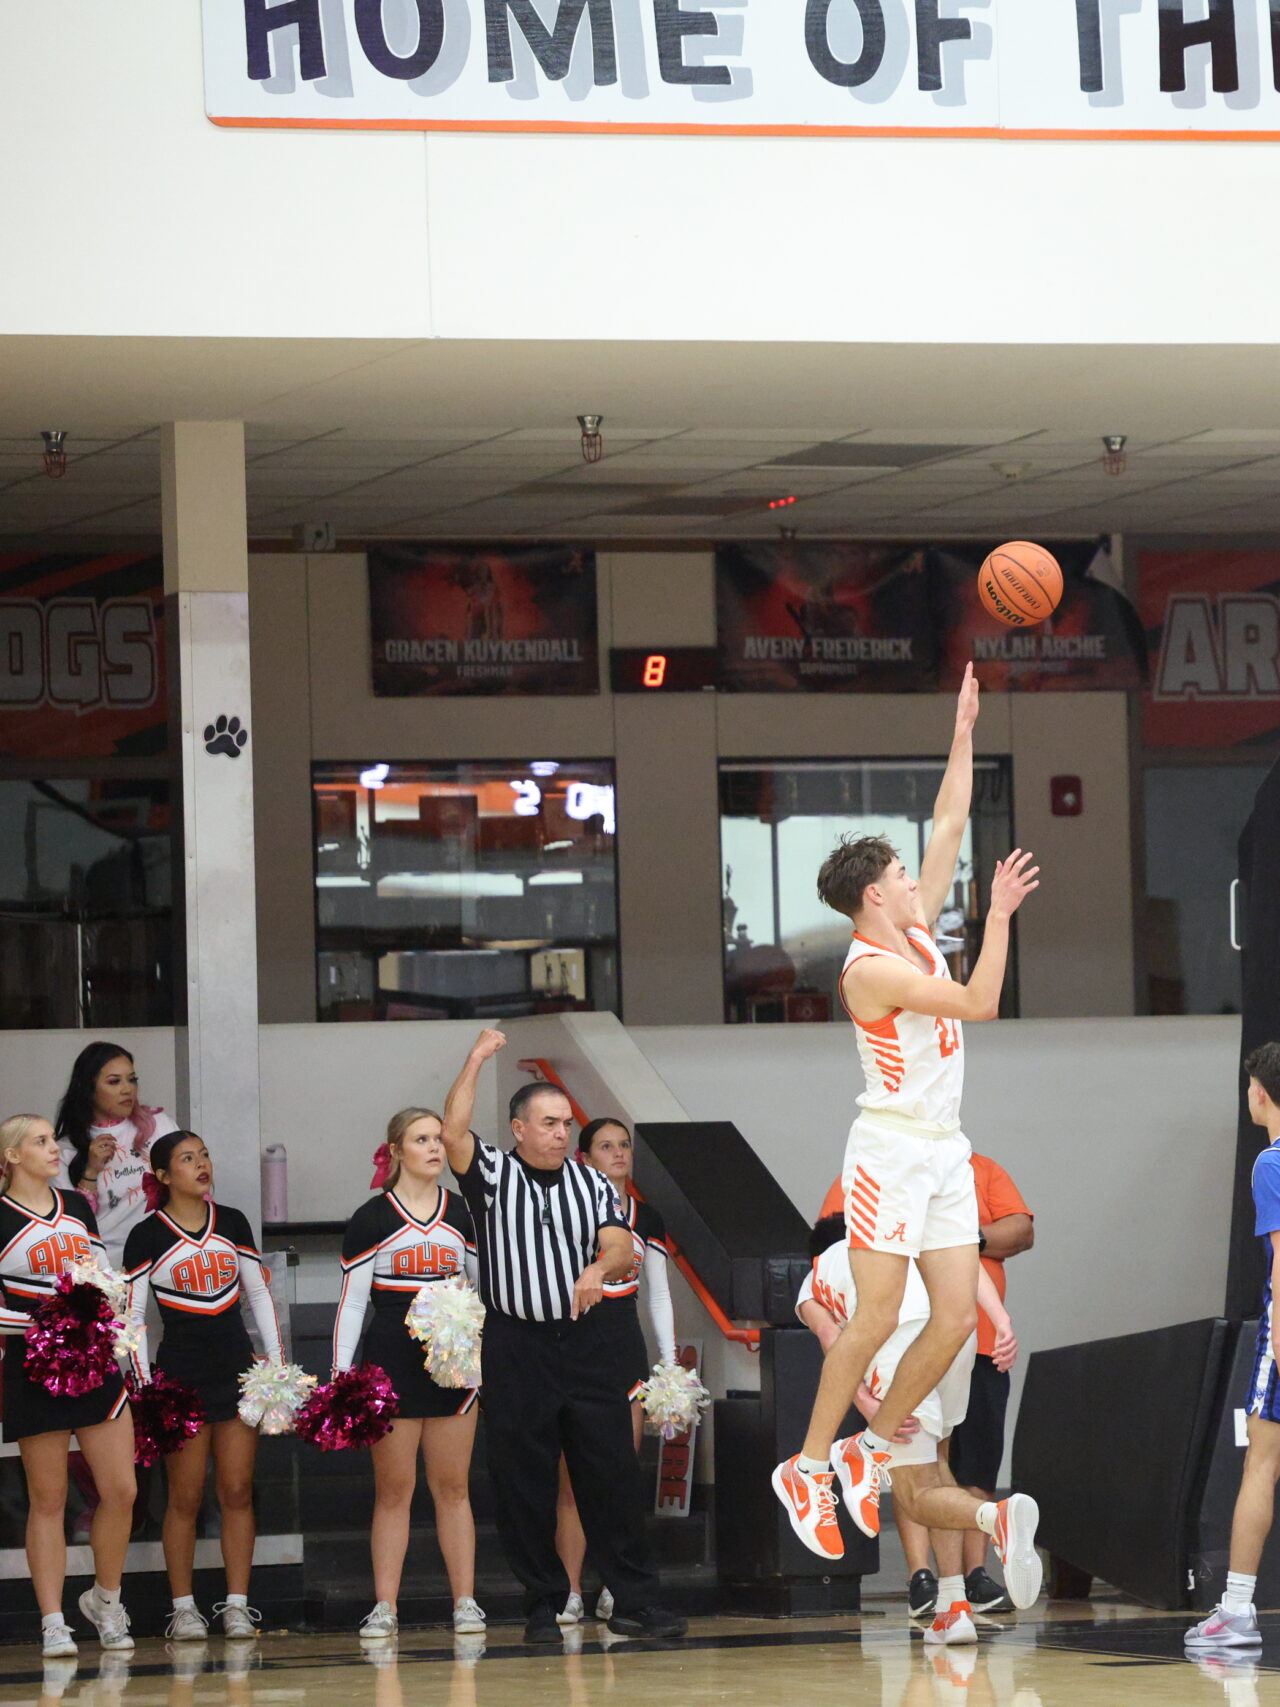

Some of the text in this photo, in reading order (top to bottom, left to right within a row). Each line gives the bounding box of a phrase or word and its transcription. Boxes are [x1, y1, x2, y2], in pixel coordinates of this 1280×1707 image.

[247, 0, 734, 86] HOME
[804, 0, 971, 91] OF
[385, 639, 584, 663] GRACEN KUYKENDALL
[743, 637, 913, 661] AVERY FREDERICK
[974, 635, 1106, 659] NYLAH ARCHIE
[643, 655, 667, 687] 8
[26, 1232, 91, 1275] AHS
[391, 1241, 459, 1276] AHS
[171, 1249, 238, 1294] AHS
